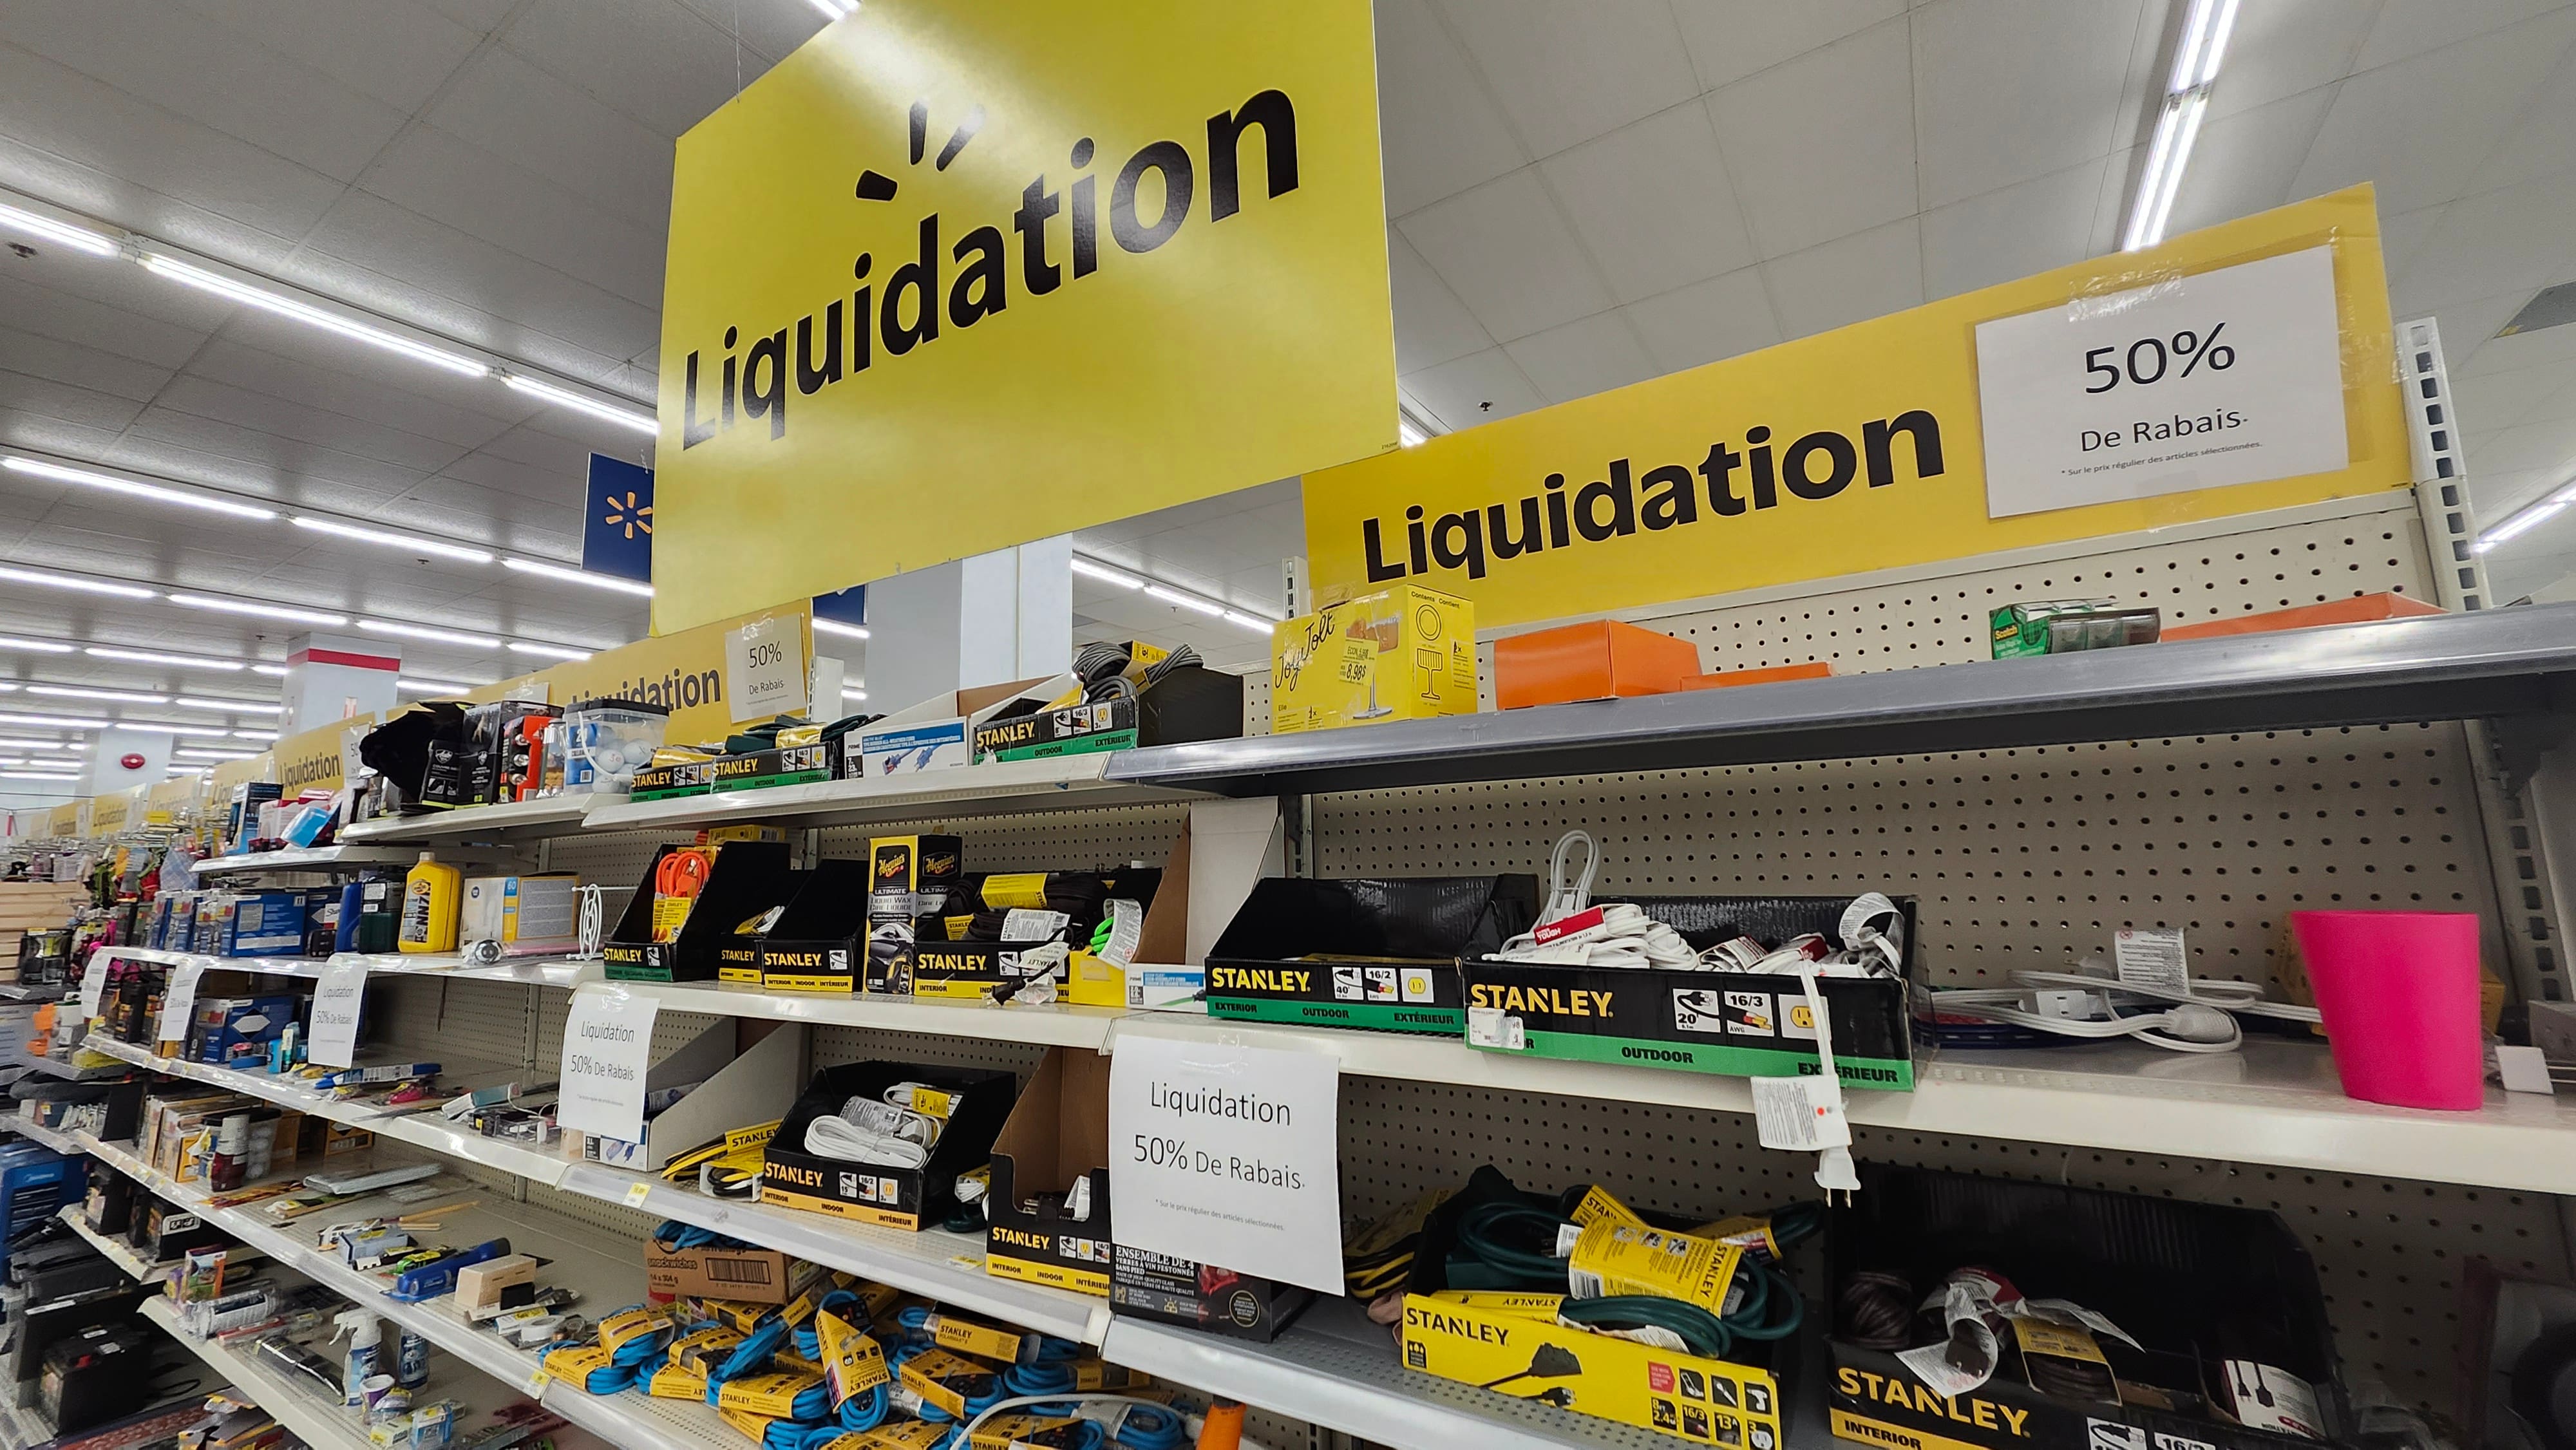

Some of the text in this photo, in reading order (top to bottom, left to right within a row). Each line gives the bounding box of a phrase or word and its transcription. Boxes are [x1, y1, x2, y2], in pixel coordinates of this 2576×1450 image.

[682, 88, 1300, 452] Liquidation
[2086, 322, 2235, 393] 50%
[2081, 430, 2121, 451] De
[2094, 464, 2110, 473] prix
[2112, 458, 2145, 470] régulier
[2165, 449, 2198, 461] articles
[1361, 408, 1946, 584] Liquidation
[1412, 591, 1460, 608] Contents Contient
[1995, 625, 2018, 639] Scotch
[748, 641, 782, 669] 50%
[748, 684, 759, 695] De
[976, 722, 1034, 748] STANLEY
[1035, 734, 1131, 756] OUTDOOR EXTÉRIEUR
[279, 752, 341, 792] Liquidation
[714, 758, 757, 776] STANLEY
[632, 772, 671, 787] STANLEY
[1539, 928, 1561, 941] TOUGH
[604, 947, 642, 962] STANLEY
[721, 950, 755, 961] STANLEY
[764, 953, 822, 966] STANLEY
[918, 954, 987, 971] STANLEY
[1212, 967, 1311, 992] STANLEY
[1369, 970, 1392, 980] 16/2
[323, 986, 354, 999] Liquidation
[1471, 984, 1613, 1017] STANLEY
[1730, 995, 1763, 1008] 16/3
[1215, 1002, 1455, 1024] EXTERIOR OUTDOOR EXTÉRIEUR
[581, 1021, 634, 1042] Liquidation
[571, 1055, 592, 1075] 50%
[594, 1062, 605, 1077] De
[1622, 1046, 1898, 1083] OUTDOOR EXÉRIEUR
[1151, 1082, 1291, 1125] Liquidation
[1134, 1135, 1188, 1170] 50%
[1196, 1151, 1222, 1176] De
[765, 1162, 824, 1188] STANLEY
[764, 1192, 912, 1226] INTERIOR INDOOR INTÉRIEUR
[1188, 1206, 1209, 1216] régulier
[1211, 1210, 1221, 1218] des
[1223, 1213, 1243, 1223] articles
[1586, 1196, 1617, 1220] STAN
[992, 1227, 1050, 1250] STANLEY
[647, 1257, 697, 1270] snackwiches
[1115, 1257, 1139, 1267] VERRES
[1145, 1261, 1156, 1270] VIN
[1157, 1264, 1194, 1277] FESTONNÉS
[1116, 1246, 1194, 1269] ENSEMBLE DE 4
[992, 1262, 1110, 1290] INTERIOR INDOOR INTÉRIEU
[1115, 1264, 1144, 1275] SANS PIED
[1700, 1245, 1727, 1297] STANLEY
[1503, 1298, 1557, 1306] STANLEY
[940, 1324, 972, 1339] STANLEY
[1406, 1307, 1510, 1347] STANLEY
[545, 1362, 562, 1374] STANLEY
[849, 1372, 888, 1392] STANLEY
[901, 1371, 925, 1389] STANLEY
[721, 1393, 751, 1405] STANLEY
[1838, 1367, 2031, 1438] STANLEY
[720, 1407, 738, 1421] STANLEY
[1683, 1406, 1705, 1420] 16/3
[1844, 1420, 1922, 1450] INTERIOR
